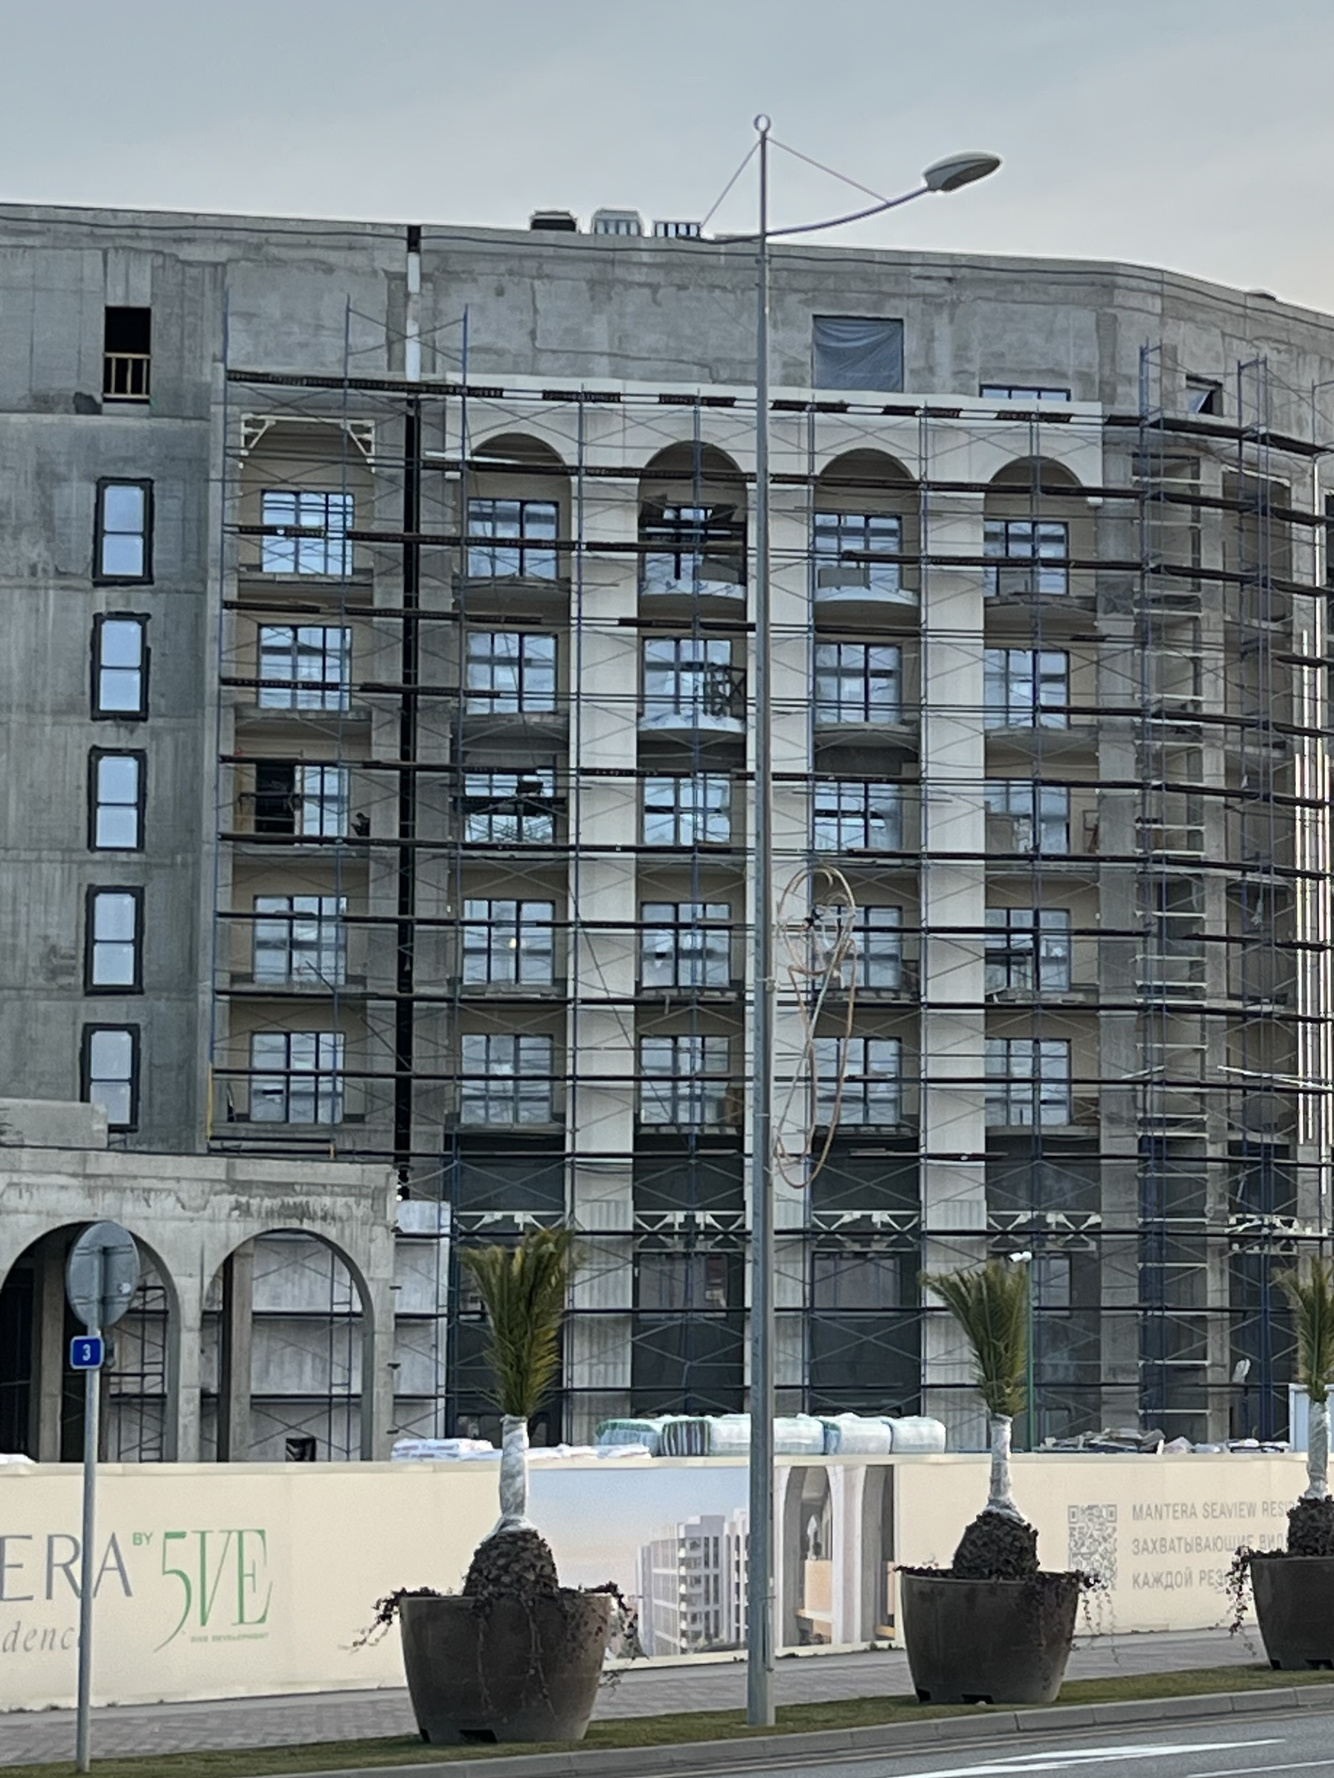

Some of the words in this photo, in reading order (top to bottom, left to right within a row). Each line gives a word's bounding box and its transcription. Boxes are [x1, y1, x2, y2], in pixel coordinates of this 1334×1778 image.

[82, 1343, 91, 1361] 3
[1132, 1502, 1198, 1521] MANTERA
[1202, 1501, 1257, 1519] SEAVIEW
[1259, 1533, 1289, 1551] ВИД
[1132, 1566, 1193, 1591] КАЖДОЙ
[1199, 1568, 1227, 1588] РЕЗ
[132, 1532, 153, 1546] BY
[154, 1529, 273, 1653] 5VE
[2, 1620, 79, 1653] denc
